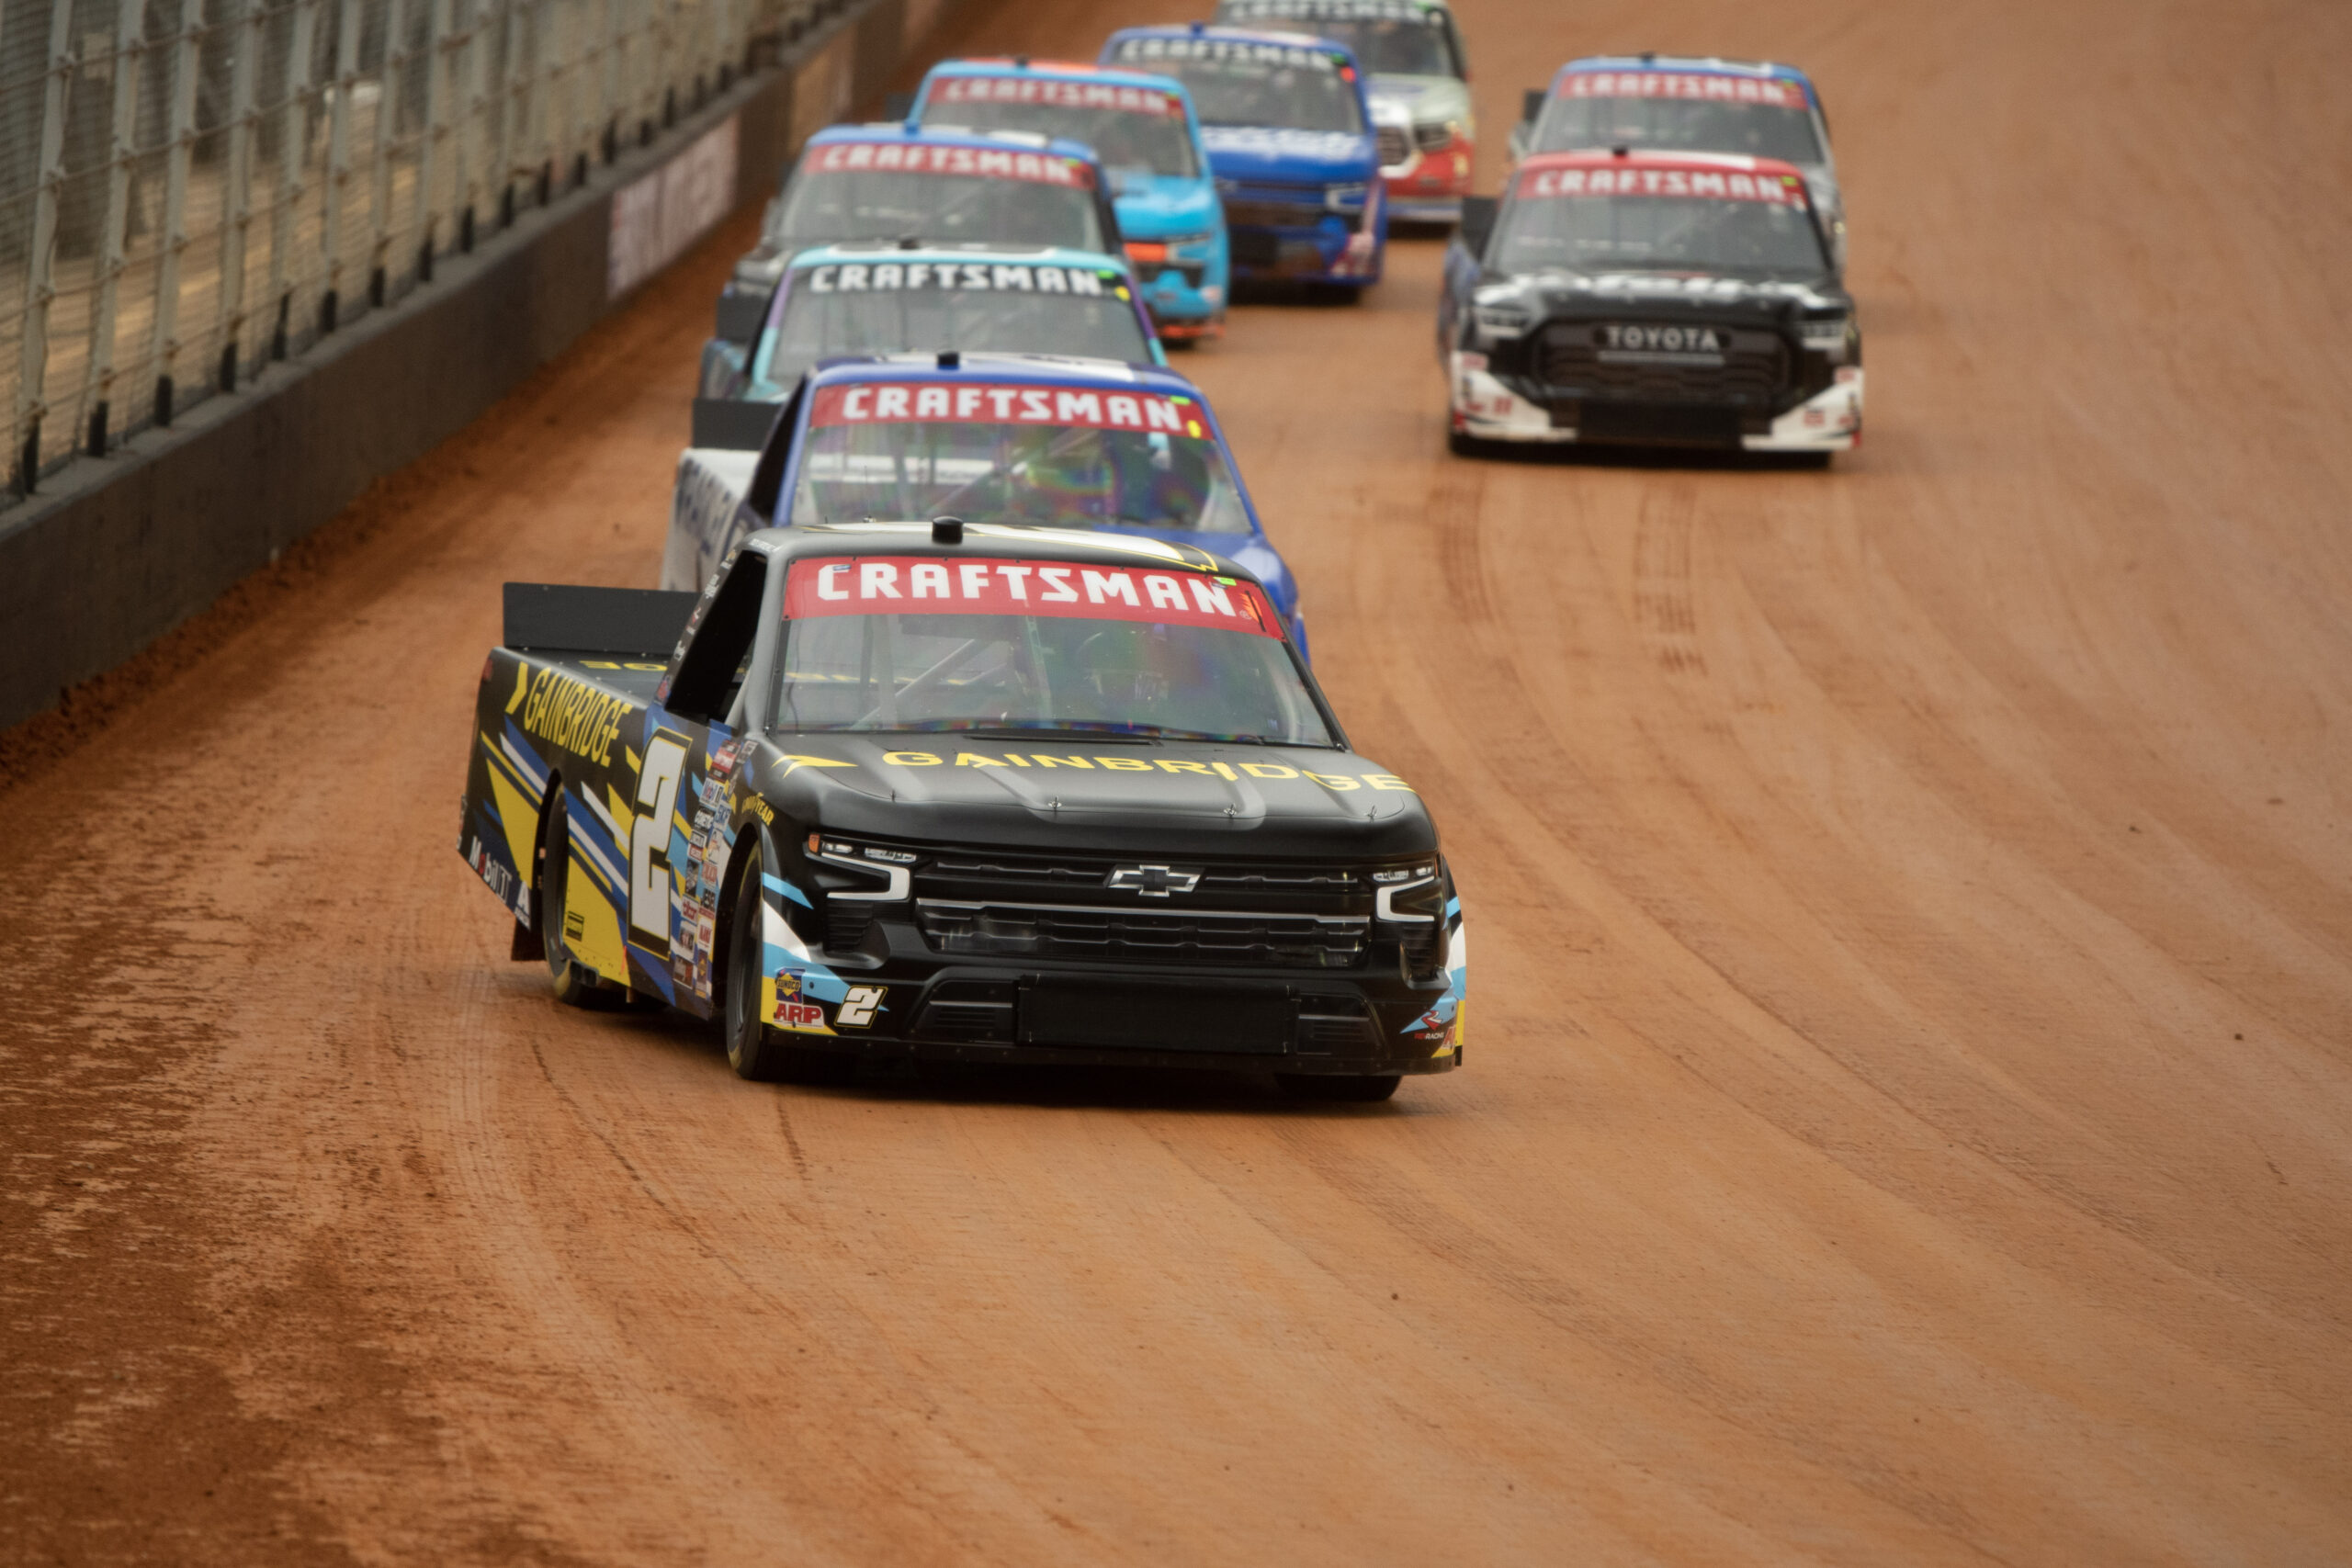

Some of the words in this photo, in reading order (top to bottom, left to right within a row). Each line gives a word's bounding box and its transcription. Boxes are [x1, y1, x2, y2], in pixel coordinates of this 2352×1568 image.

[1118, 38, 1335, 71] CRAFTSMAN
[945, 78, 1170, 112] CRAFTSMAN
[1571, 73, 1785, 101] CRAFTSMAN
[823, 144, 1073, 182] CRAFTSMAN
[1534, 169, 1785, 200] CRAFTSMAN
[808, 264, 1102, 297] CRAFTSMAN
[1605, 325, 1722, 352] TOYOTA
[842, 386, 1184, 432] CRAFTSMAN
[817, 562, 1238, 617] CRAFTSMAN
[523, 666, 633, 768] GAINBRIDGE
[880, 749, 1416, 793] GAINBRIDGE
[629, 731, 689, 946] 2
[777, 978, 801, 991] SUNOCO
[775, 1003, 822, 1023] ARP
[835, 986, 887, 1027] 2
